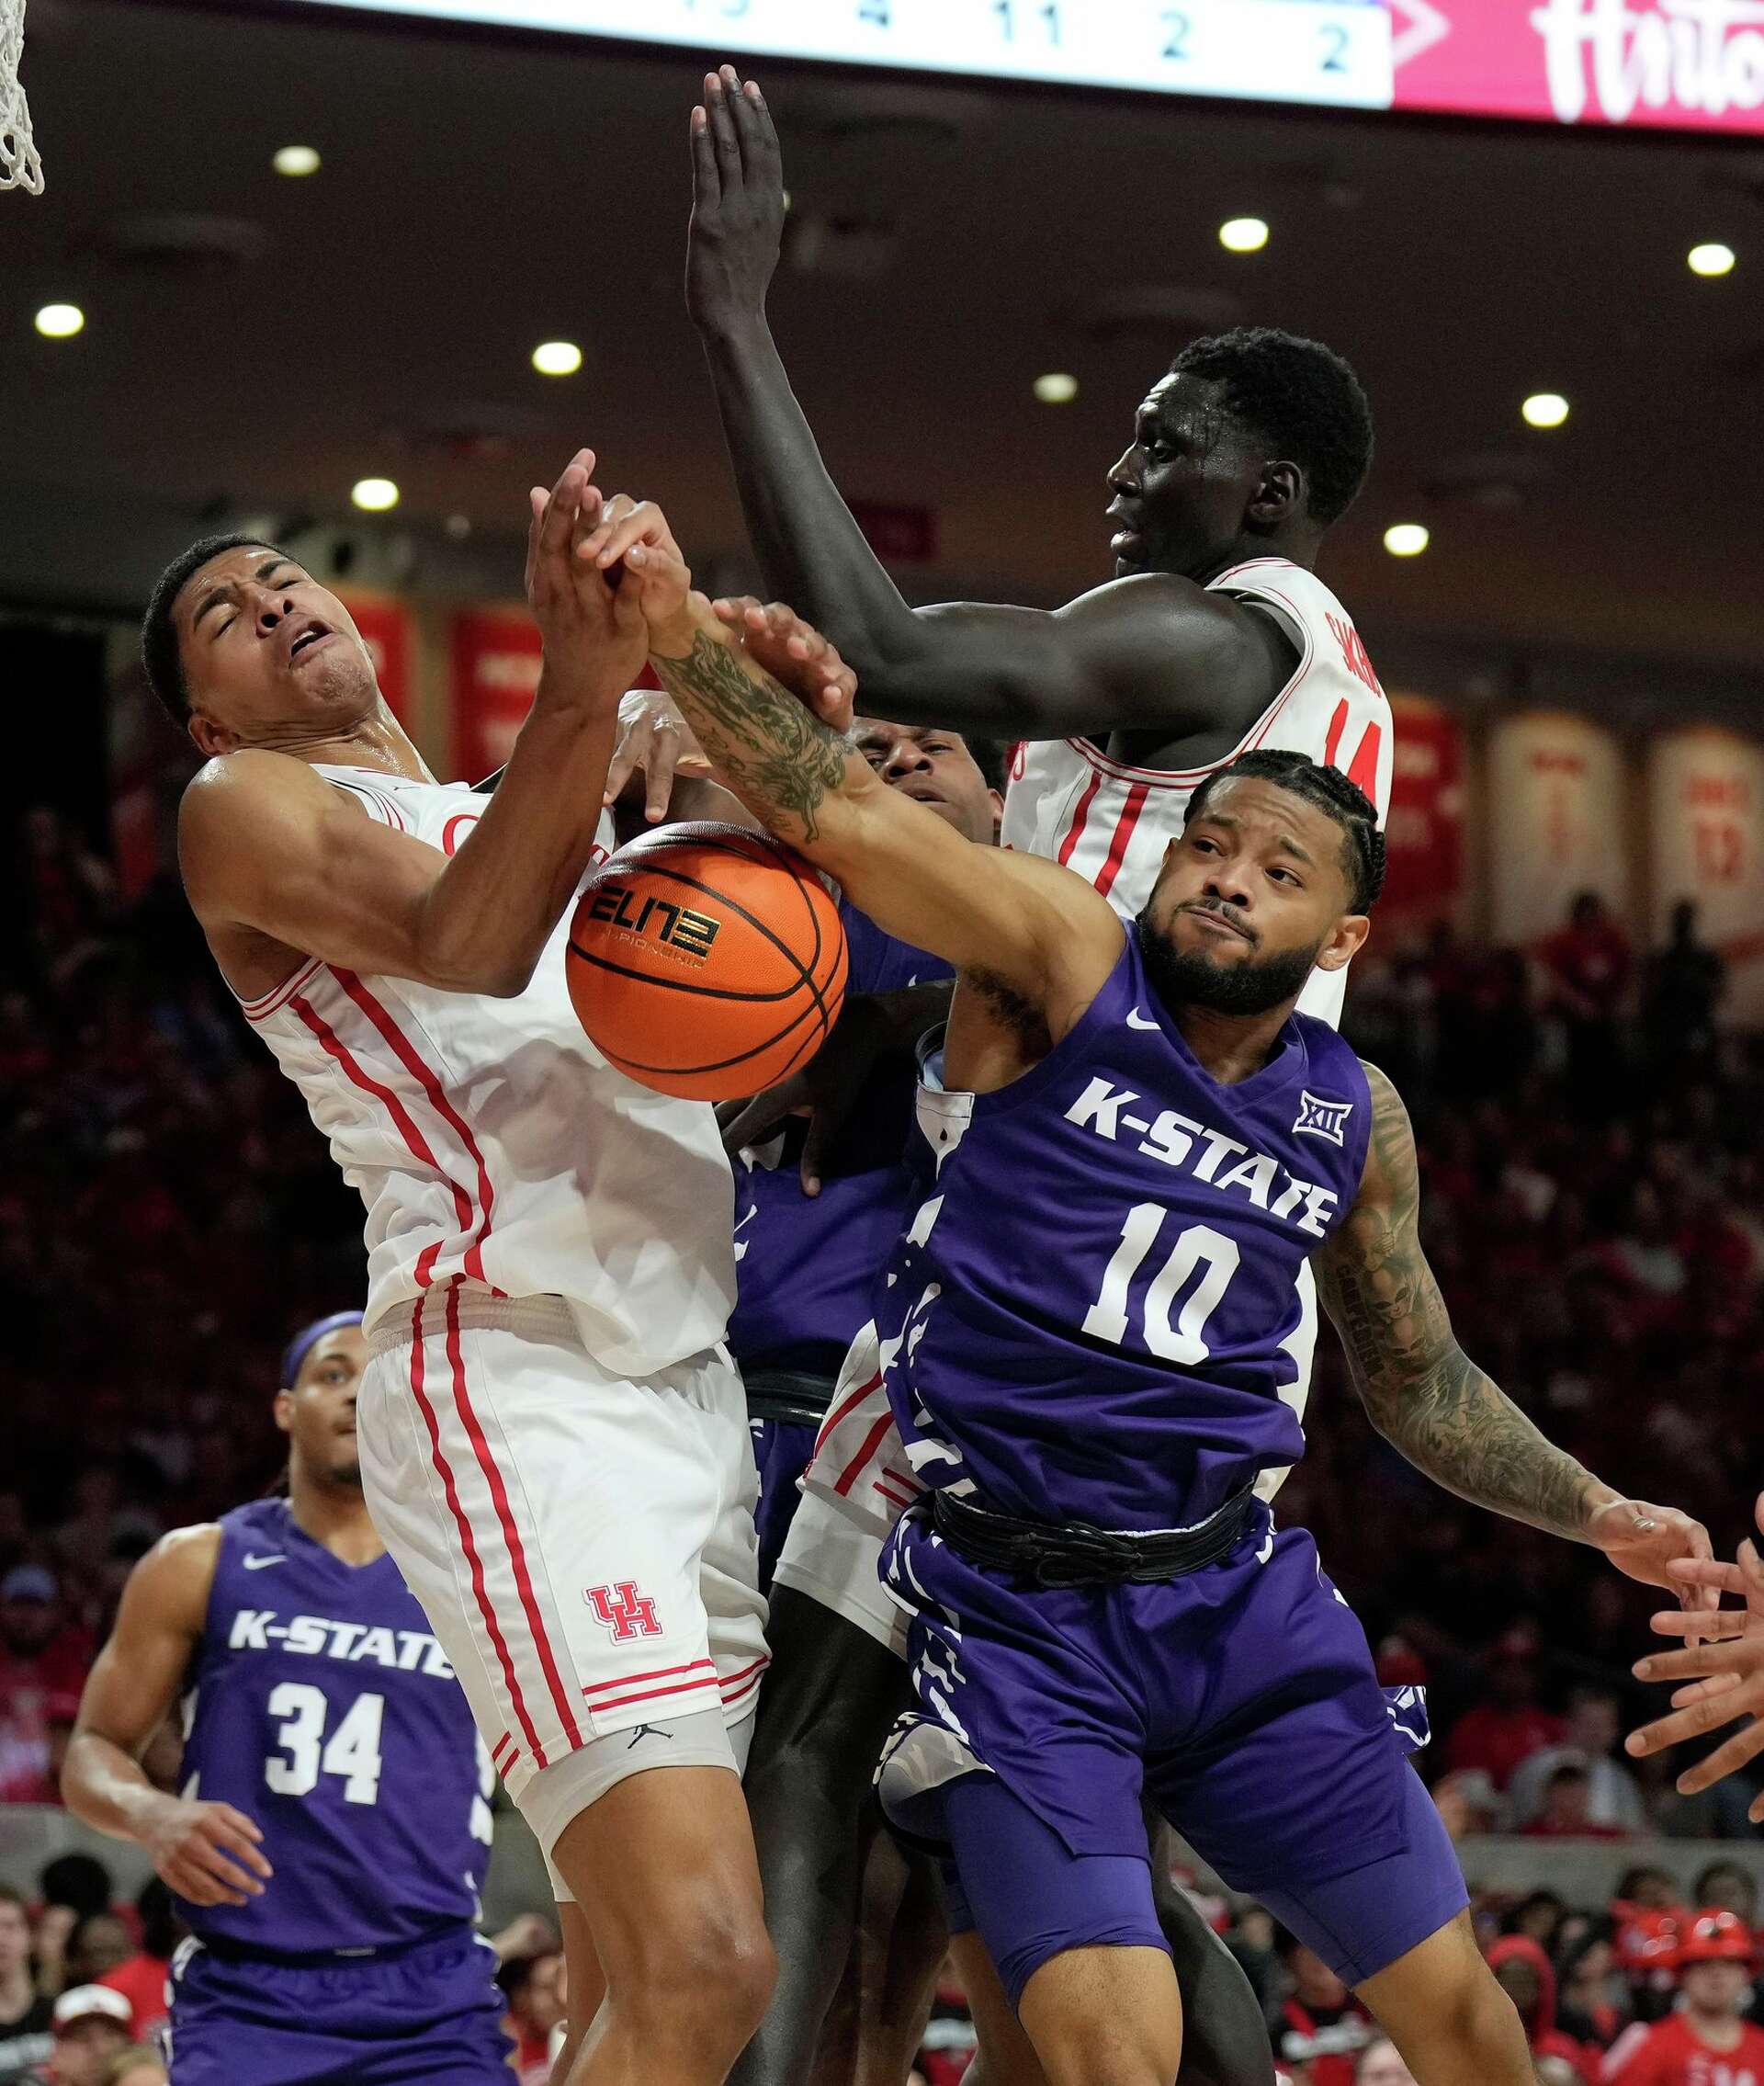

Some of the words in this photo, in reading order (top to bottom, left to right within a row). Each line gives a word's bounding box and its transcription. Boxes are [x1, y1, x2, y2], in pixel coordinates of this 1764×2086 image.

[1159, 11, 1193, 61] 2
[1317, 22, 1351, 74] 2
[589, 886, 721, 960] ELITE
[1064, 1076, 1340, 1239] K-STATE
[1080, 1202, 1240, 1366] 10
[265, 1682, 385, 1805] 34
